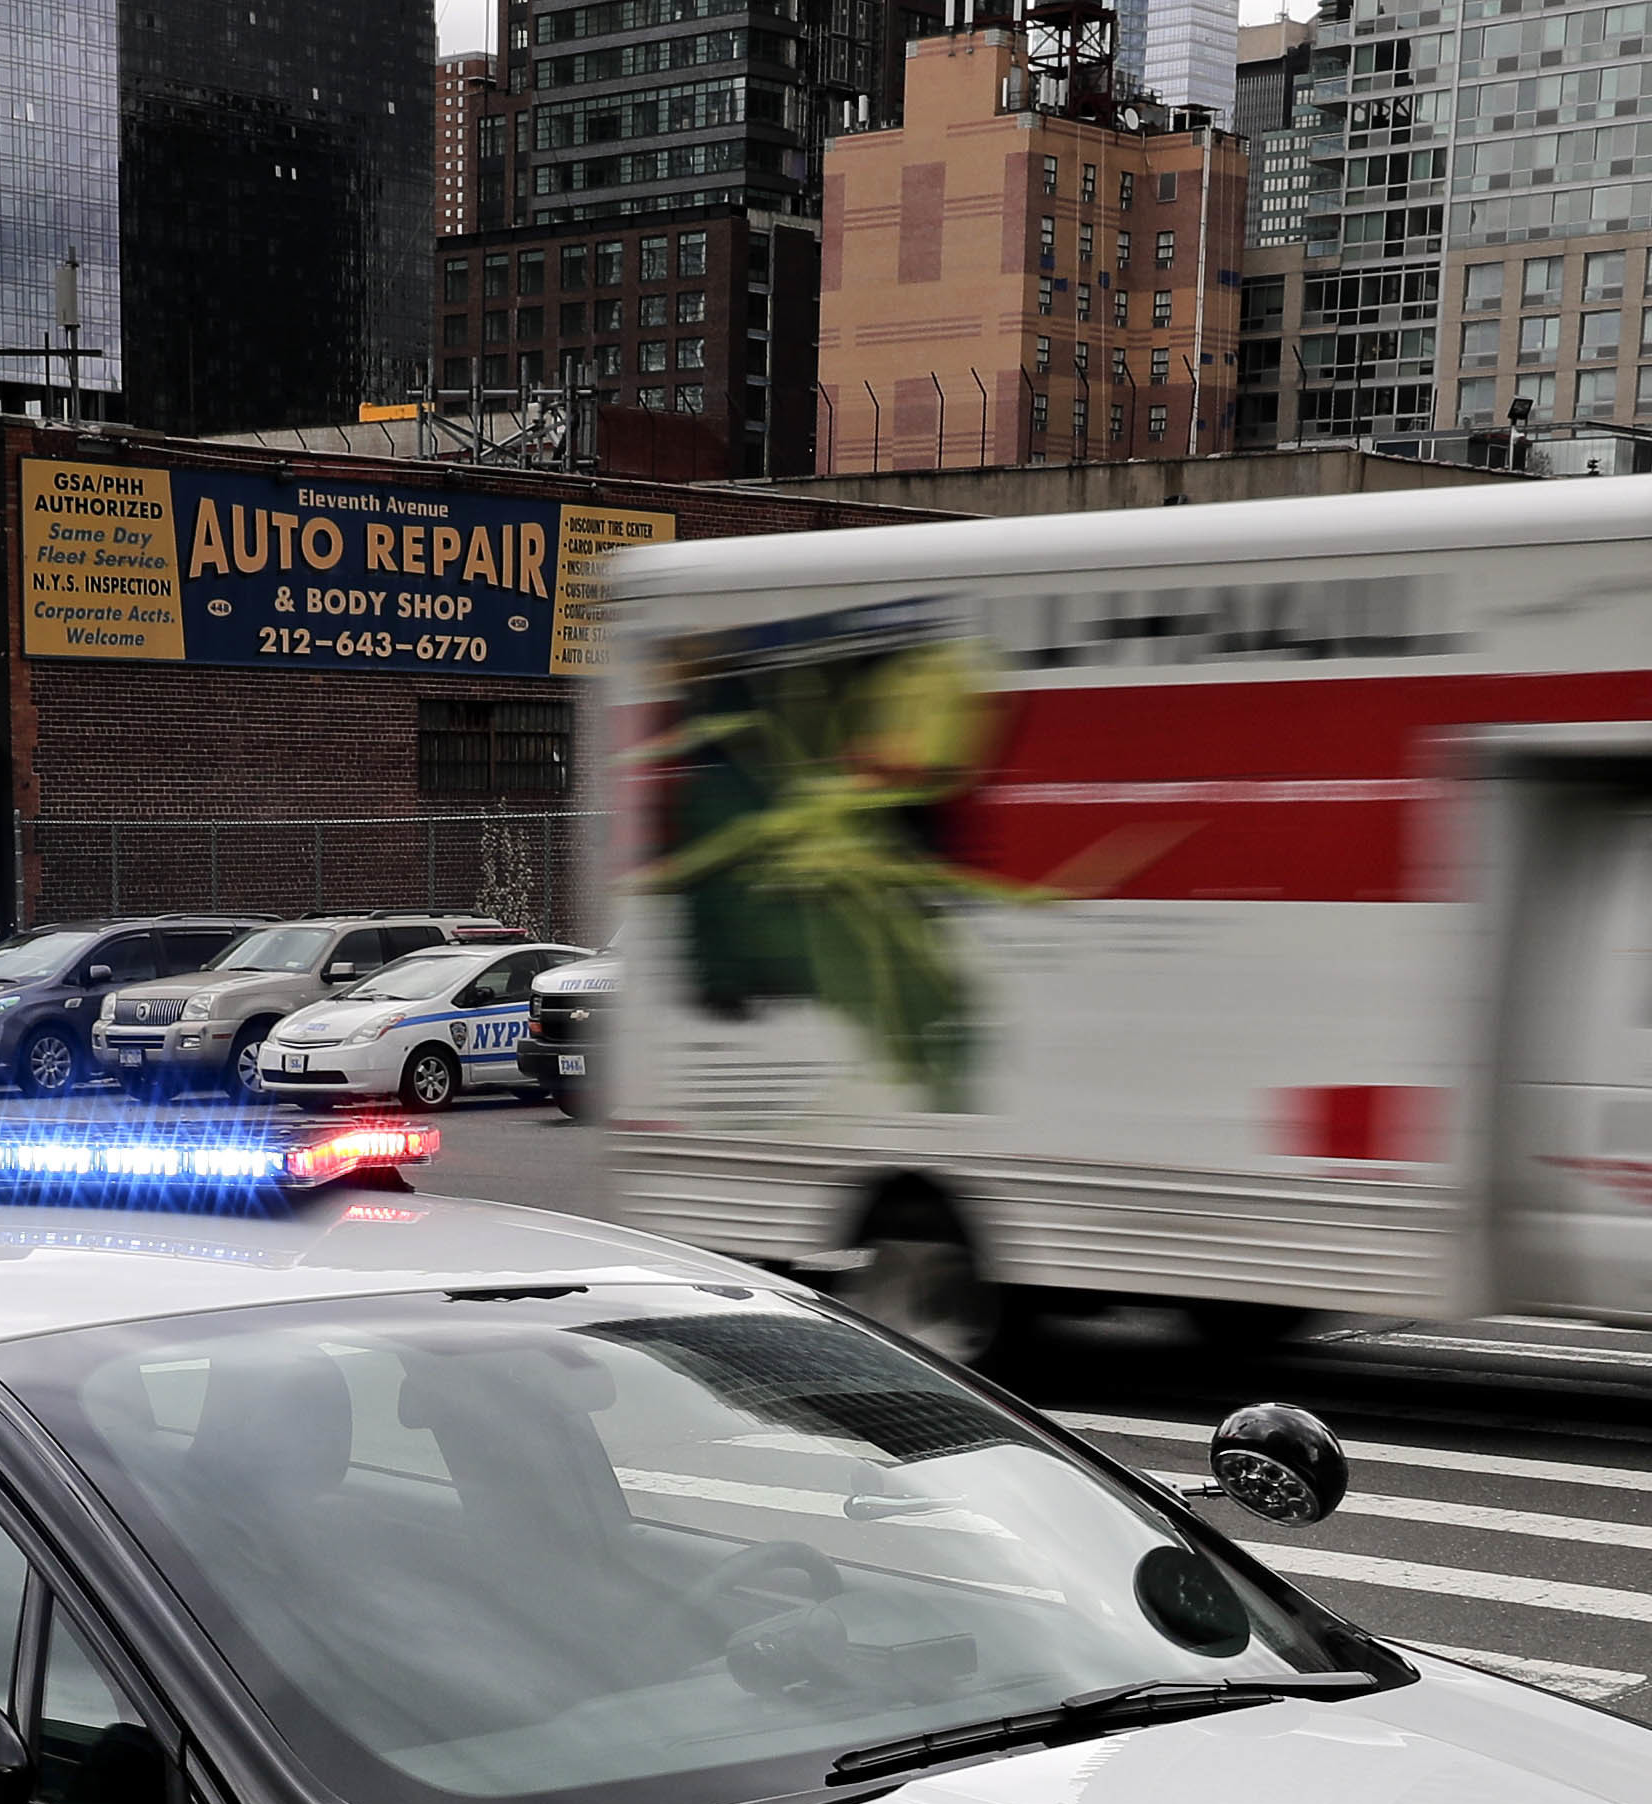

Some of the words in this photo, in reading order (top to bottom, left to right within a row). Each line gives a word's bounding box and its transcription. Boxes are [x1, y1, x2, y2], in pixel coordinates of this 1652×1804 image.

[54, 472, 143, 496] GSA/PHH
[35, 495, 163, 520] AUTHORIZED
[298, 488, 381, 512] Eleventh
[386, 495, 449, 519] Avenue
[49, 522, 105, 542] Same
[113, 527, 152, 549] Day
[569, 517, 605, 535] DISCOUNT
[608, 521, 624, 536] TIRE
[626, 522, 653, 539] CENTER
[37, 546, 86, 565] Fleet
[93, 549, 166, 569] Service
[189, 497, 344, 579] AUTO
[367, 521, 548, 600] REPAIR
[568, 538, 593, 555] CARCO
[33, 573, 79, 593] N.Y.S.
[85, 576, 171, 596] INSPECTION
[565, 582, 599, 599] CUSTOM
[34, 601, 122, 623] Corporate
[128, 605, 175, 624] Accts.
[275, 585, 296, 613] &
[307, 588, 387, 617] BODY
[398, 592, 473, 621] SHOP
[66, 627, 145, 646] Welcome
[259, 626, 487, 662] 212-643-6770
[563, 626, 589, 642] FRAME
[561, 648, 583, 664] AUTO
